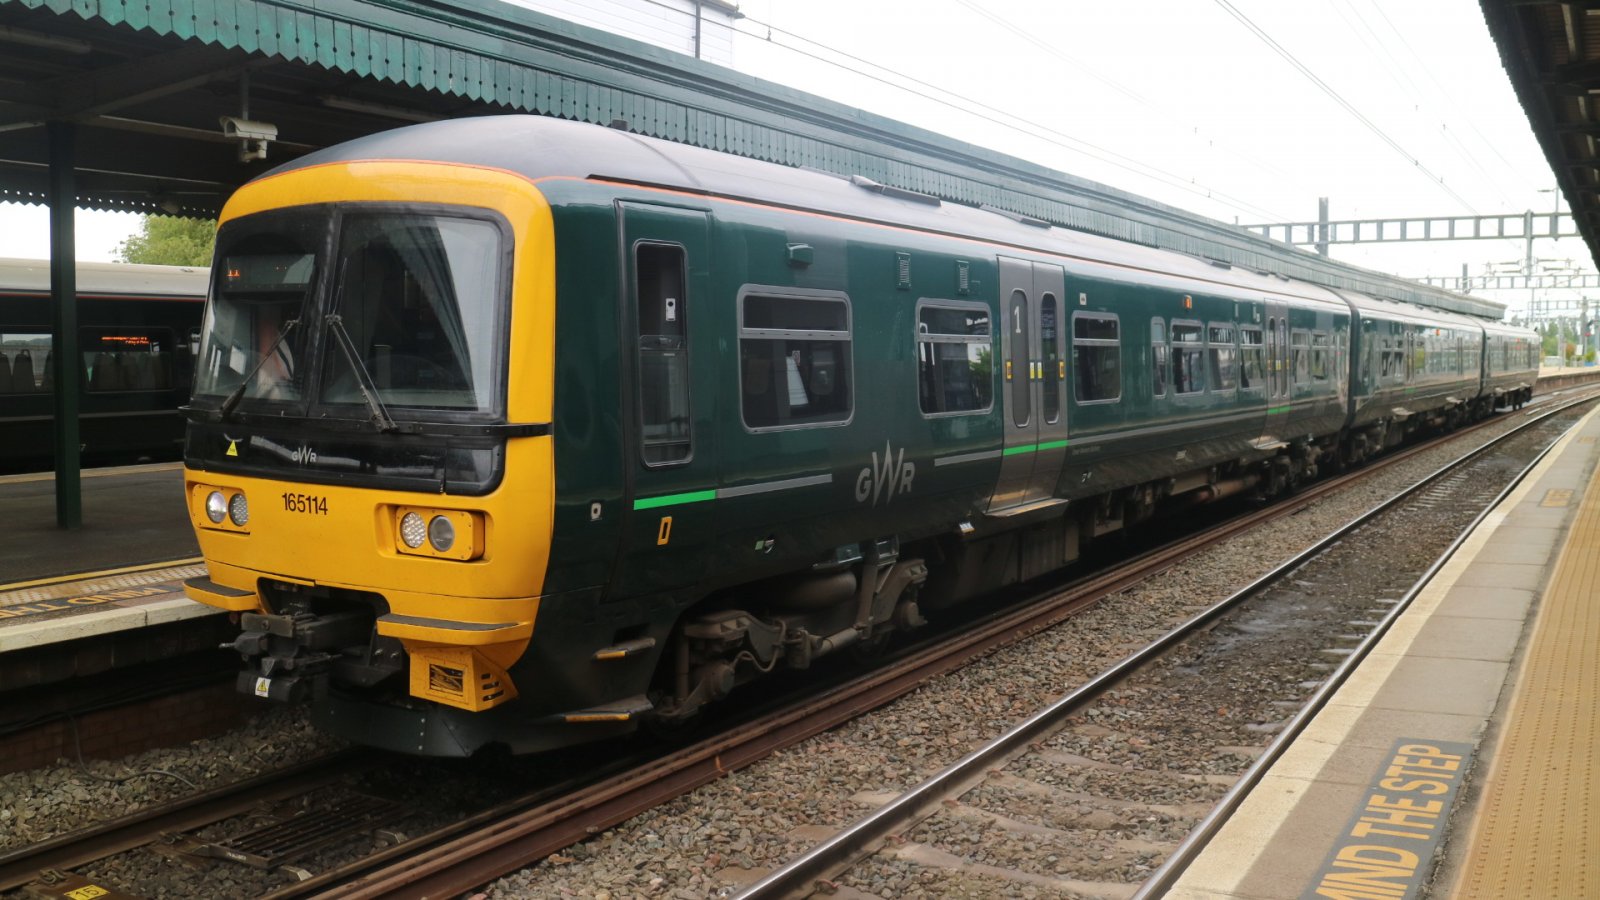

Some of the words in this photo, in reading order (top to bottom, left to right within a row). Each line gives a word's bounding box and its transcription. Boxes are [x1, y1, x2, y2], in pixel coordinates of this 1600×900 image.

[1013, 305, 1022, 334] 1
[291, 445, 317, 464] GWR
[856, 439, 916, 508] GWR
[282, 492, 328, 516] 165114
[1379, 744, 1462, 795] STEP
[1350, 794, 1444, 840] THE
